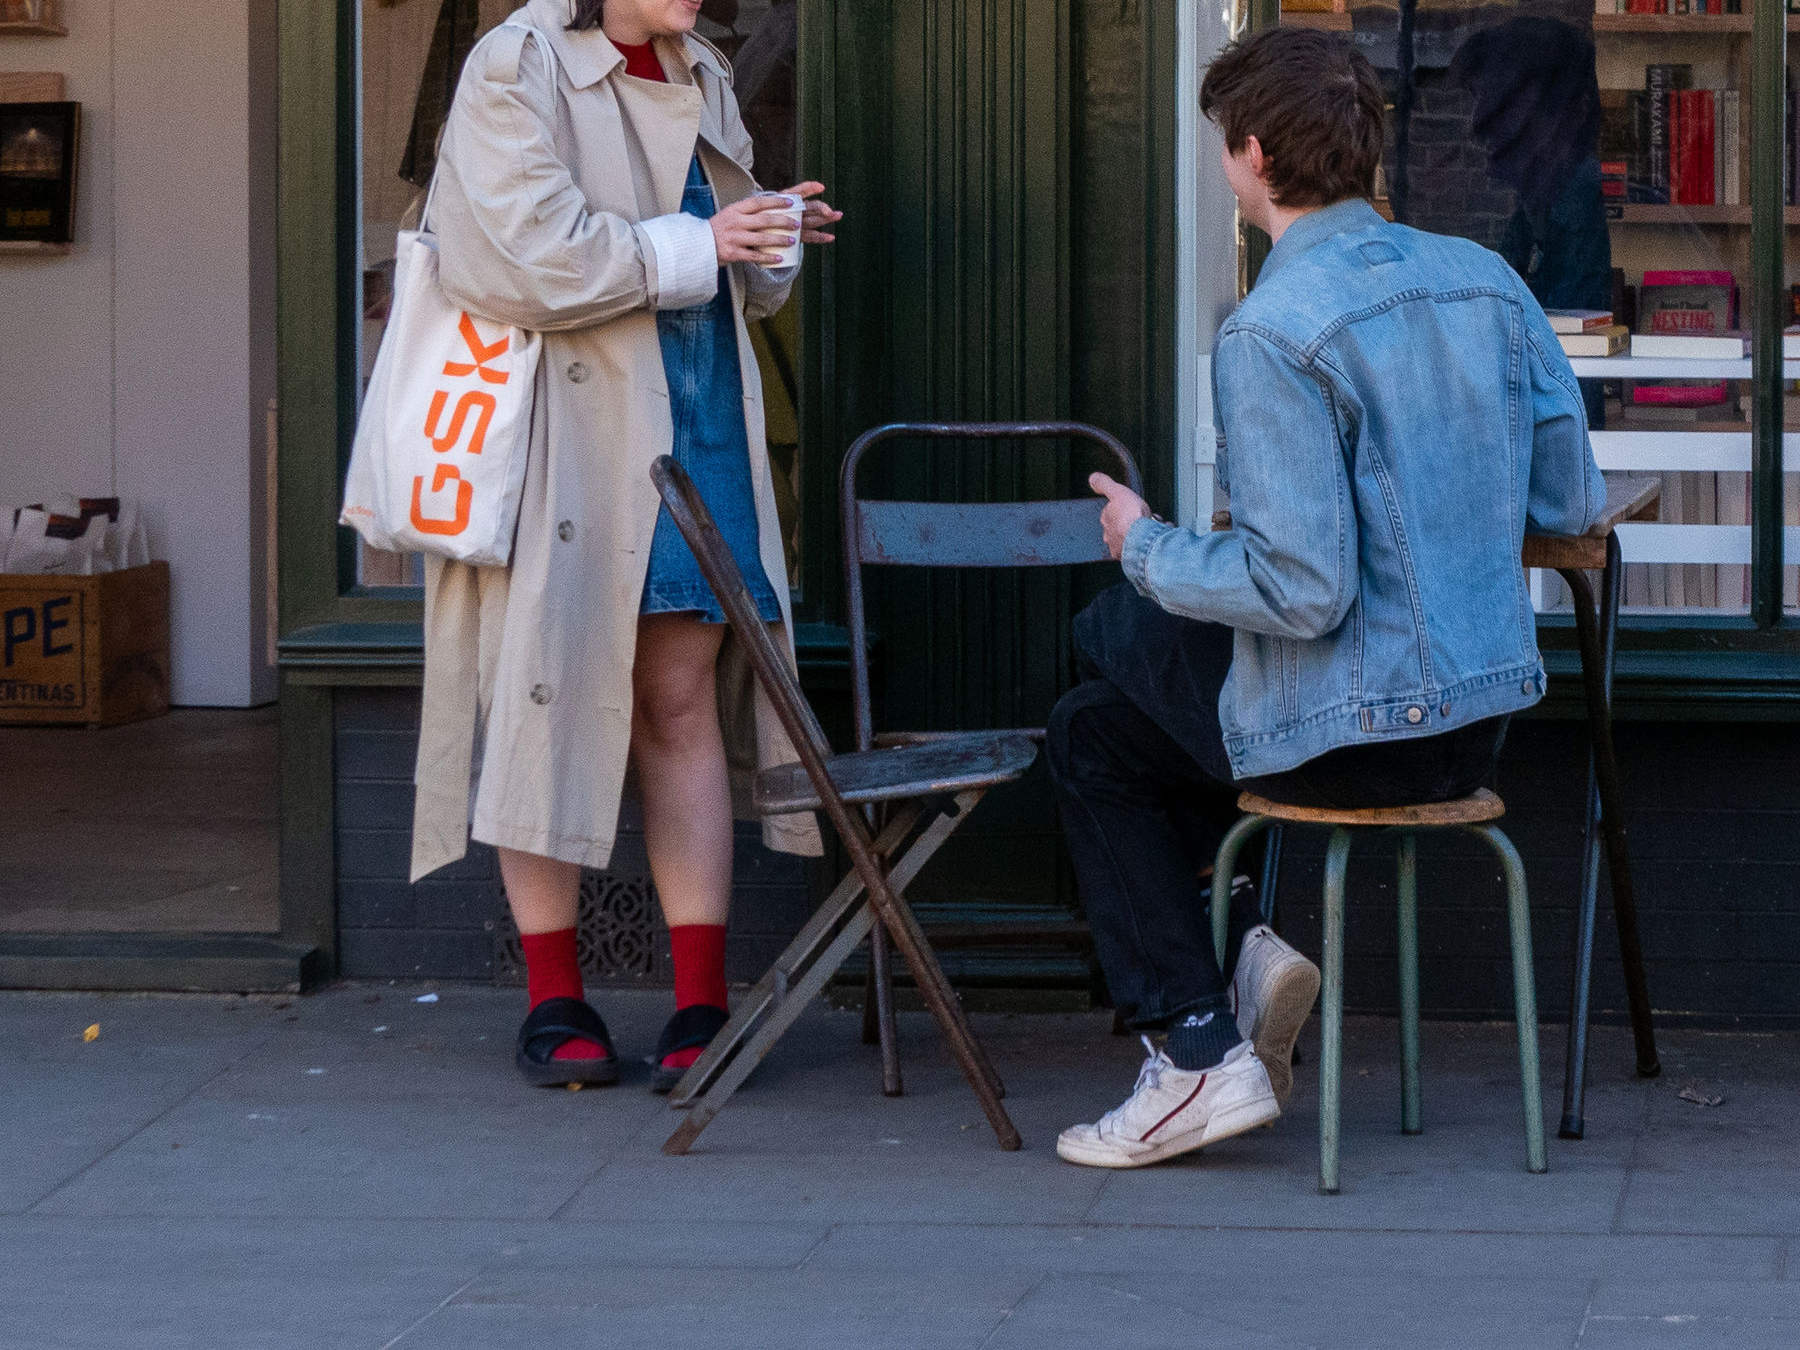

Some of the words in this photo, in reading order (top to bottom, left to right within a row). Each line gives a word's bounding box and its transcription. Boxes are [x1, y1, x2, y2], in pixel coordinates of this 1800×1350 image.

[1651, 67, 1663, 145] MURAKAMI
[409, 310, 511, 537] GSK
[5, 596, 74, 668] PE
